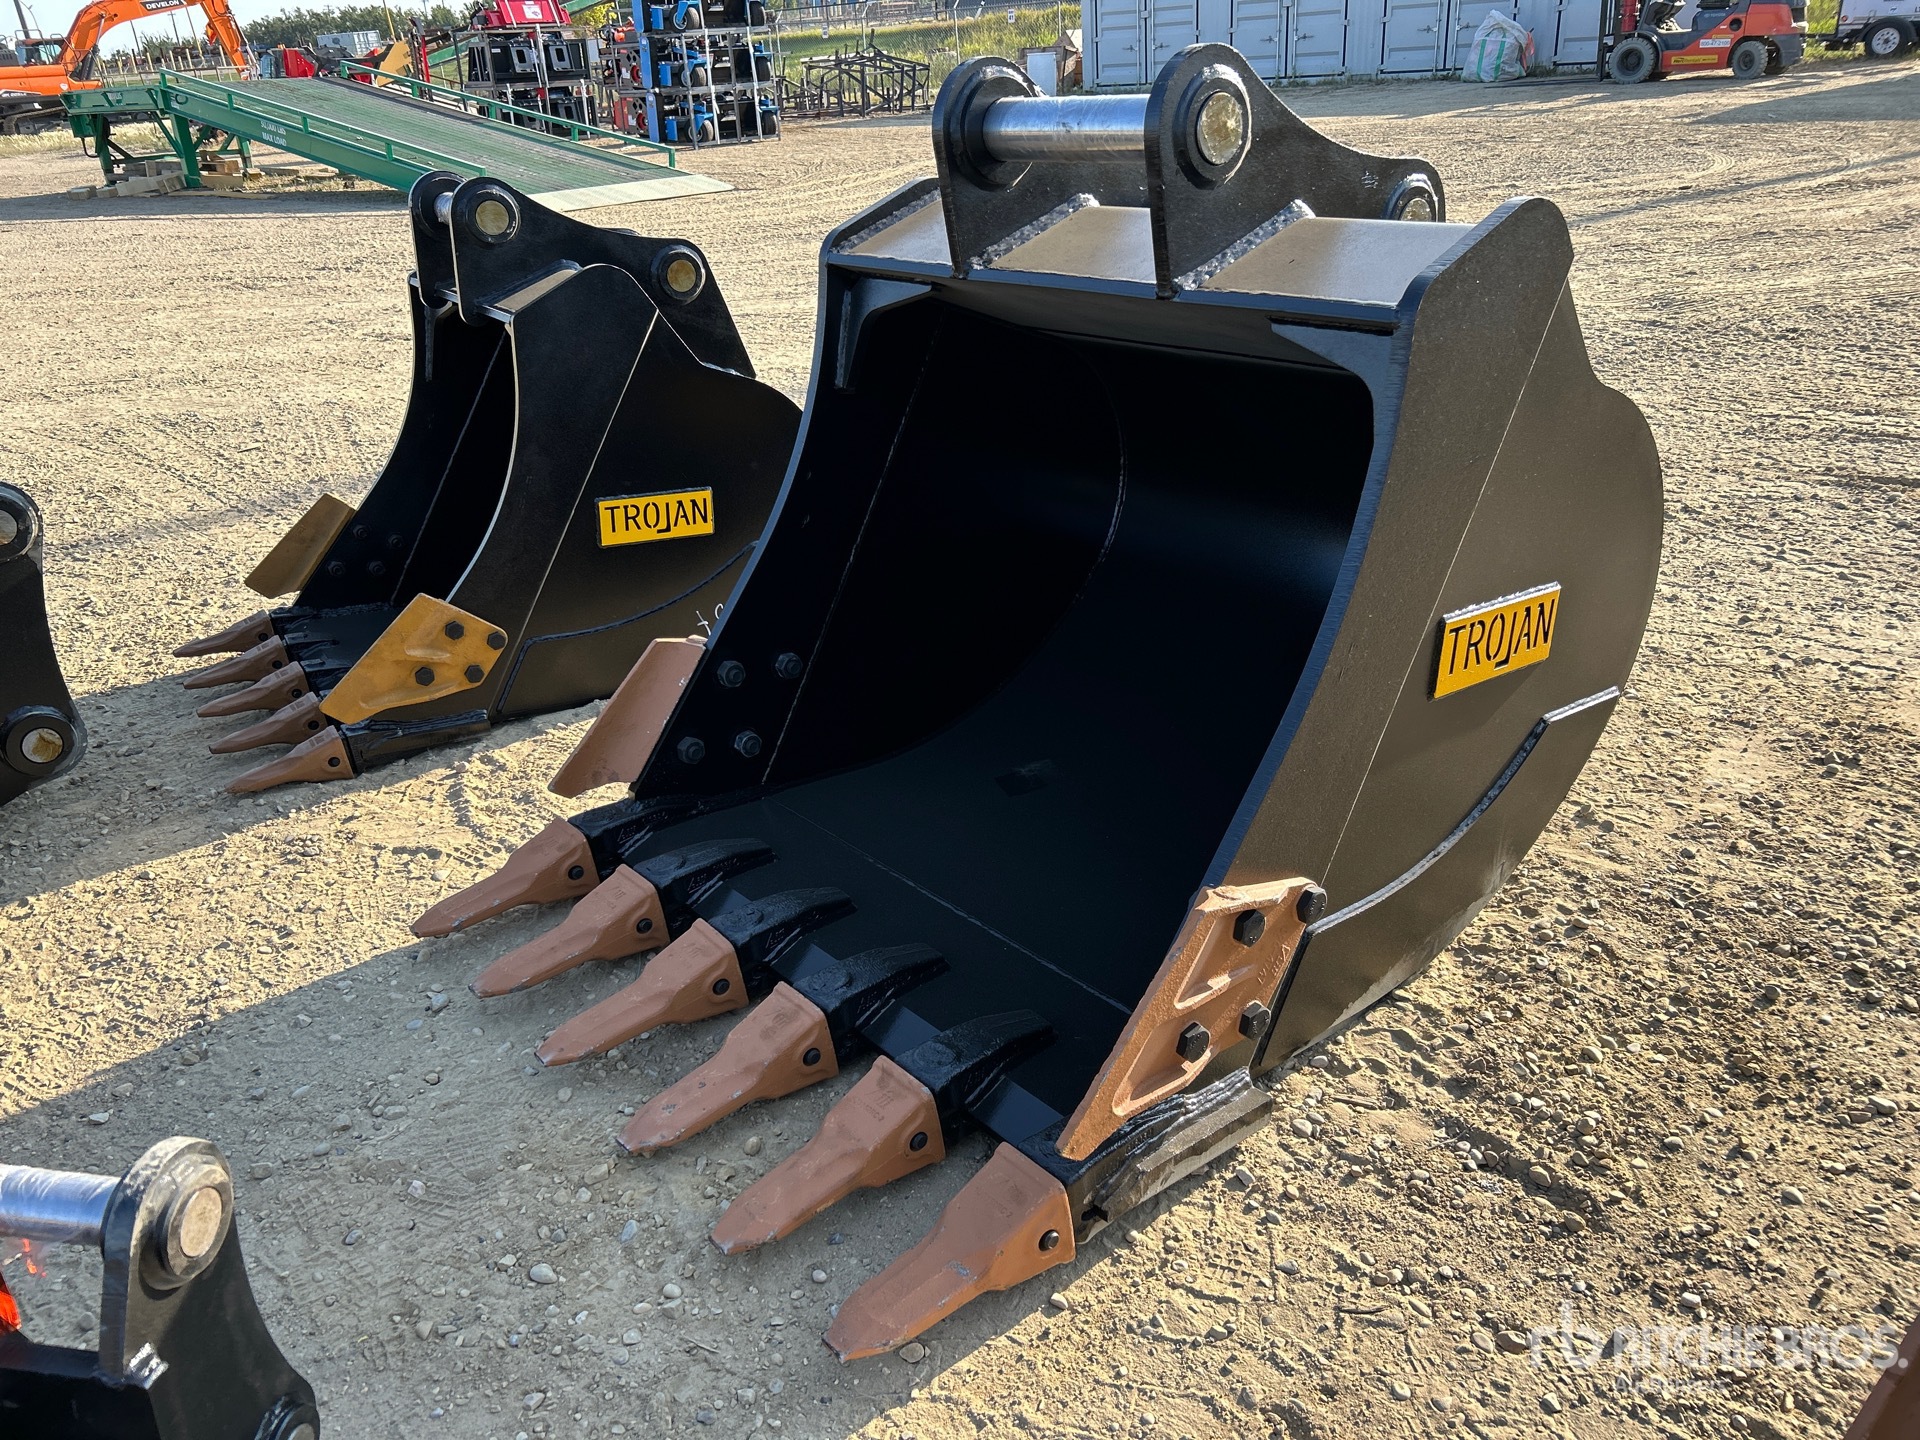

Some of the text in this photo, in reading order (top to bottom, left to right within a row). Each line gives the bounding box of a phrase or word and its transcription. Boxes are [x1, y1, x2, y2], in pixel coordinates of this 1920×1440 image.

[145, 0, 180, 9] DEVELON
[604, 498, 708, 534] TROJAN
[1448, 598, 1556, 675] TROJAN
